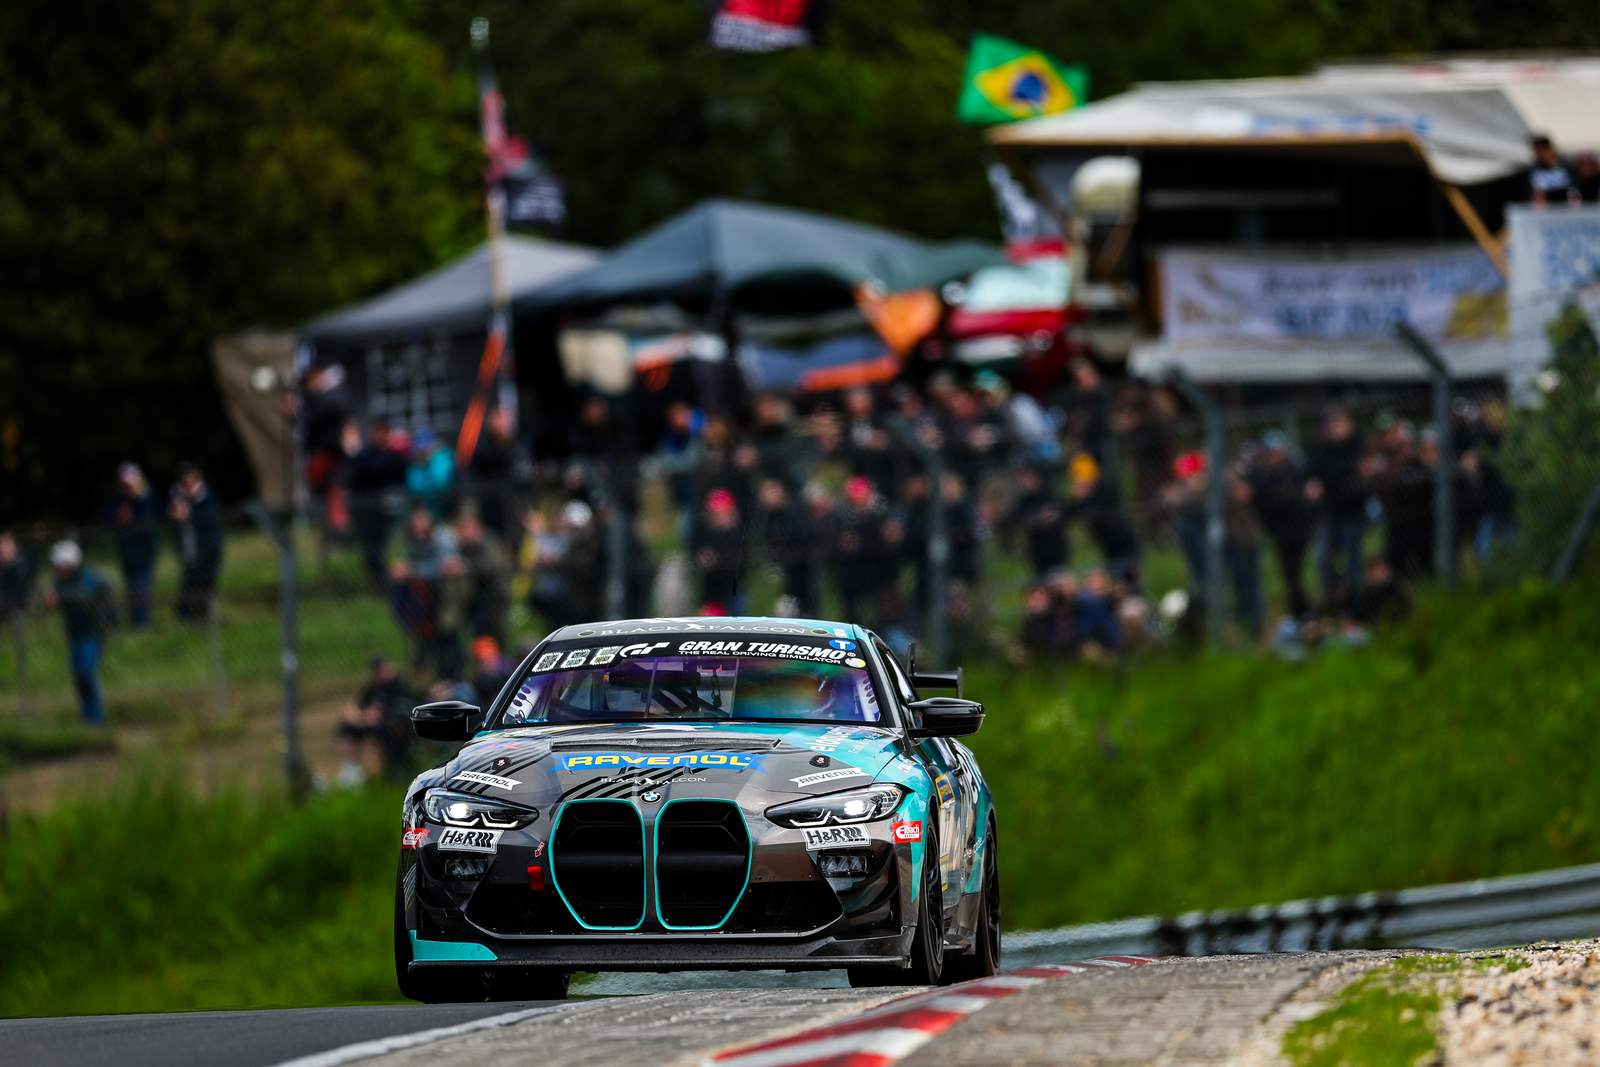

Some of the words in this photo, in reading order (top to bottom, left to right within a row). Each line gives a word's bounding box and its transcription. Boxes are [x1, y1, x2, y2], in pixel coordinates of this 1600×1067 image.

[601, 624, 680, 636] BLACK
[708, 625, 805, 635] FALCON
[678, 641, 746, 652] GRAN
[747, 642, 847, 660] TURISMO
[778, 654, 842, 665] SIMULATOR
[567, 755, 751, 768] RAVENOL
[460, 772, 514, 787] RAVENOL
[798, 769, 860, 784] RAVENOL
[441, 830, 482, 847] H&R
[806, 828, 850, 843] H&R
